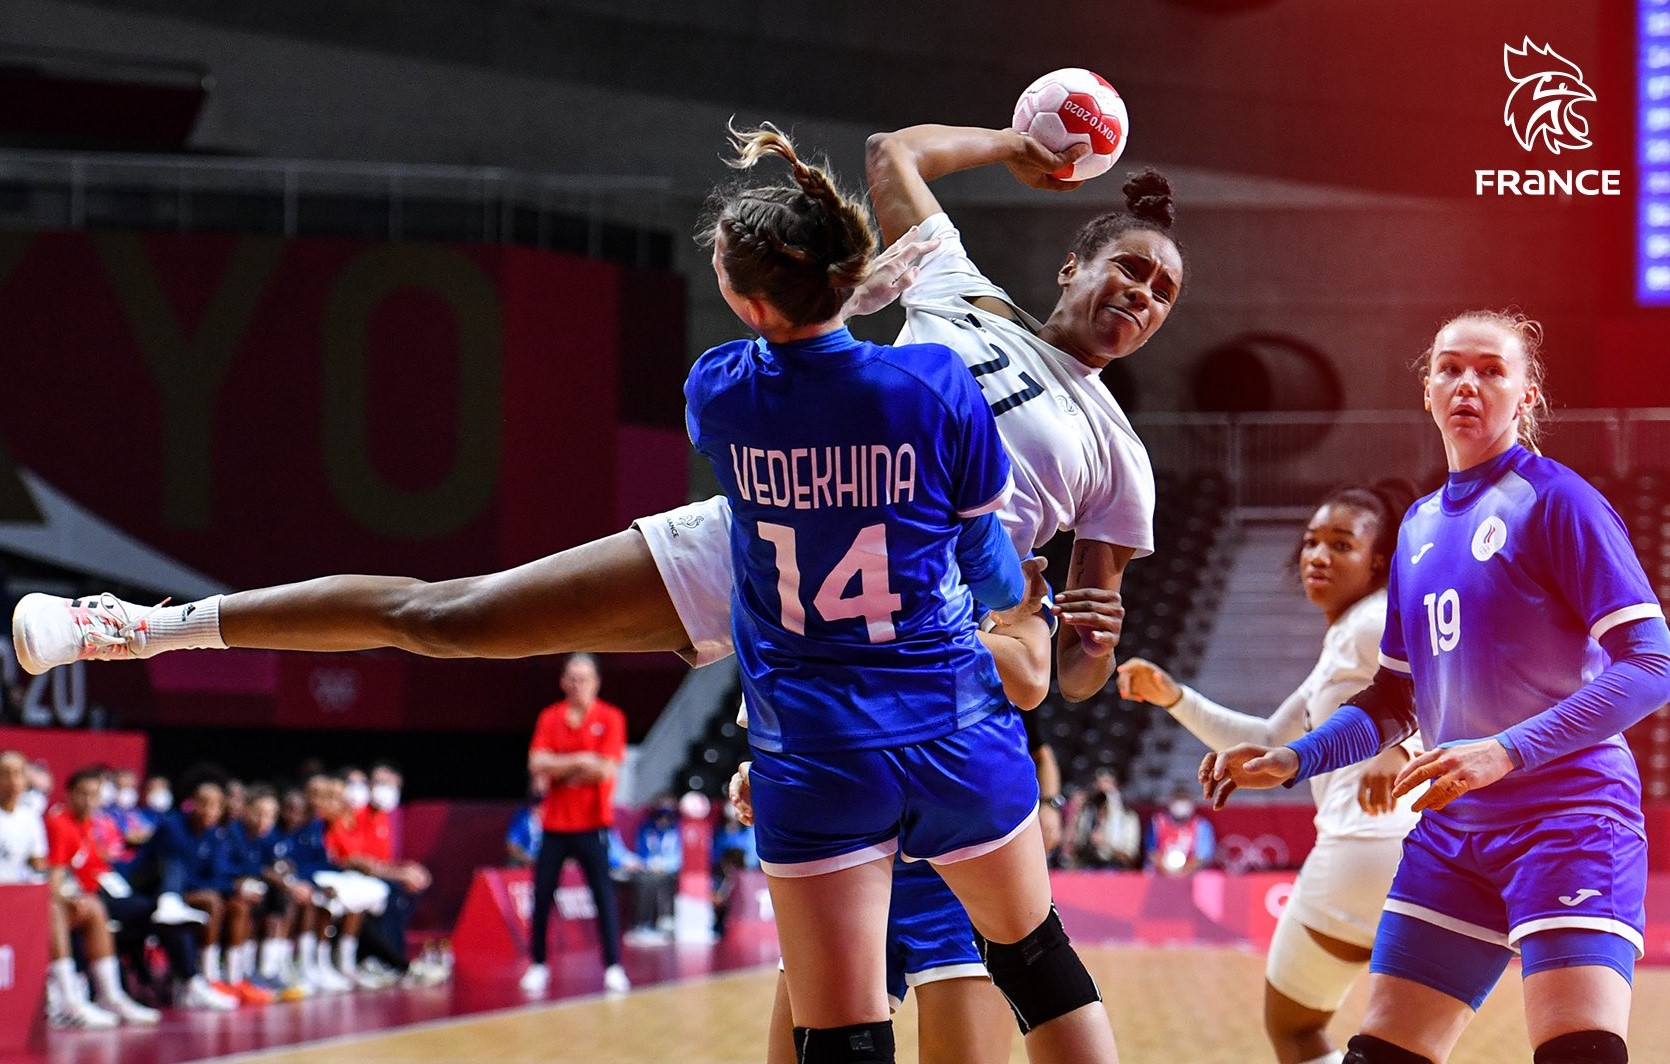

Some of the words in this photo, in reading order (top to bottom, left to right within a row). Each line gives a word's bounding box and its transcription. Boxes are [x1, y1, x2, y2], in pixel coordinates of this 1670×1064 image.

[1064, 100, 1092, 122] 2020
[1089, 116, 1118, 145] TOKYO
[730, 443, 916, 509] VEDEKHINA
[757, 521, 902, 643] 14
[1423, 588, 1461, 656] 19
